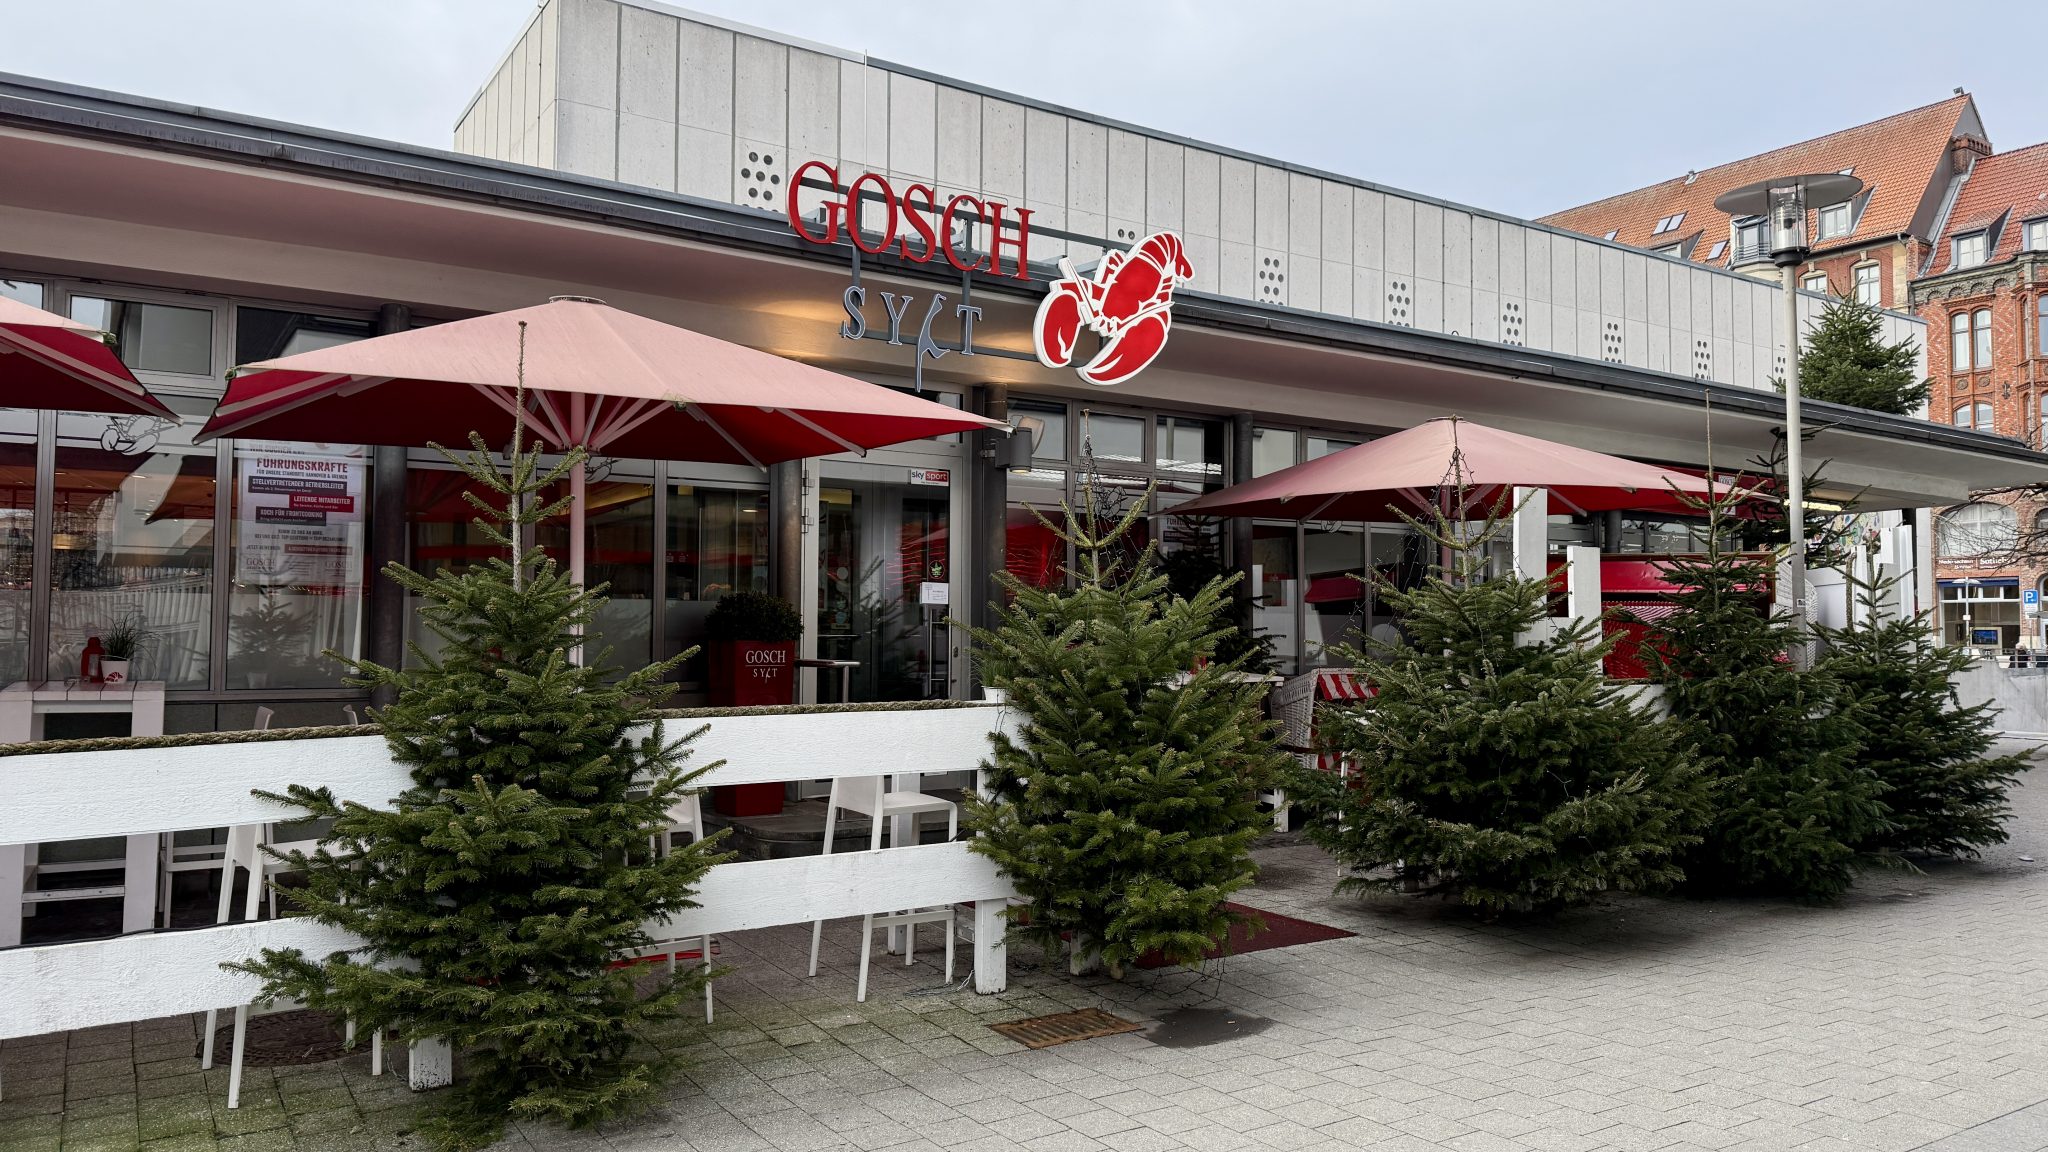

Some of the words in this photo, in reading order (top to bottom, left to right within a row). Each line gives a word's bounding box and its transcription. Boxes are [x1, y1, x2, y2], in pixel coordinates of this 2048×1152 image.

[787, 160, 1036, 282] GOSCH
[841, 285, 983, 393] SYLT
[911, 470, 925, 480] sky
[926, 472, 947, 481] sport
[293, 495, 317, 503] LEITENDE
[318, 497, 351, 505] MITARBEITER
[275, 508, 285, 516] FÜR
[2025, 591, 2034, 602] P
[745, 650, 786, 664] GOSCH
[752, 667, 778, 684] SYLT
